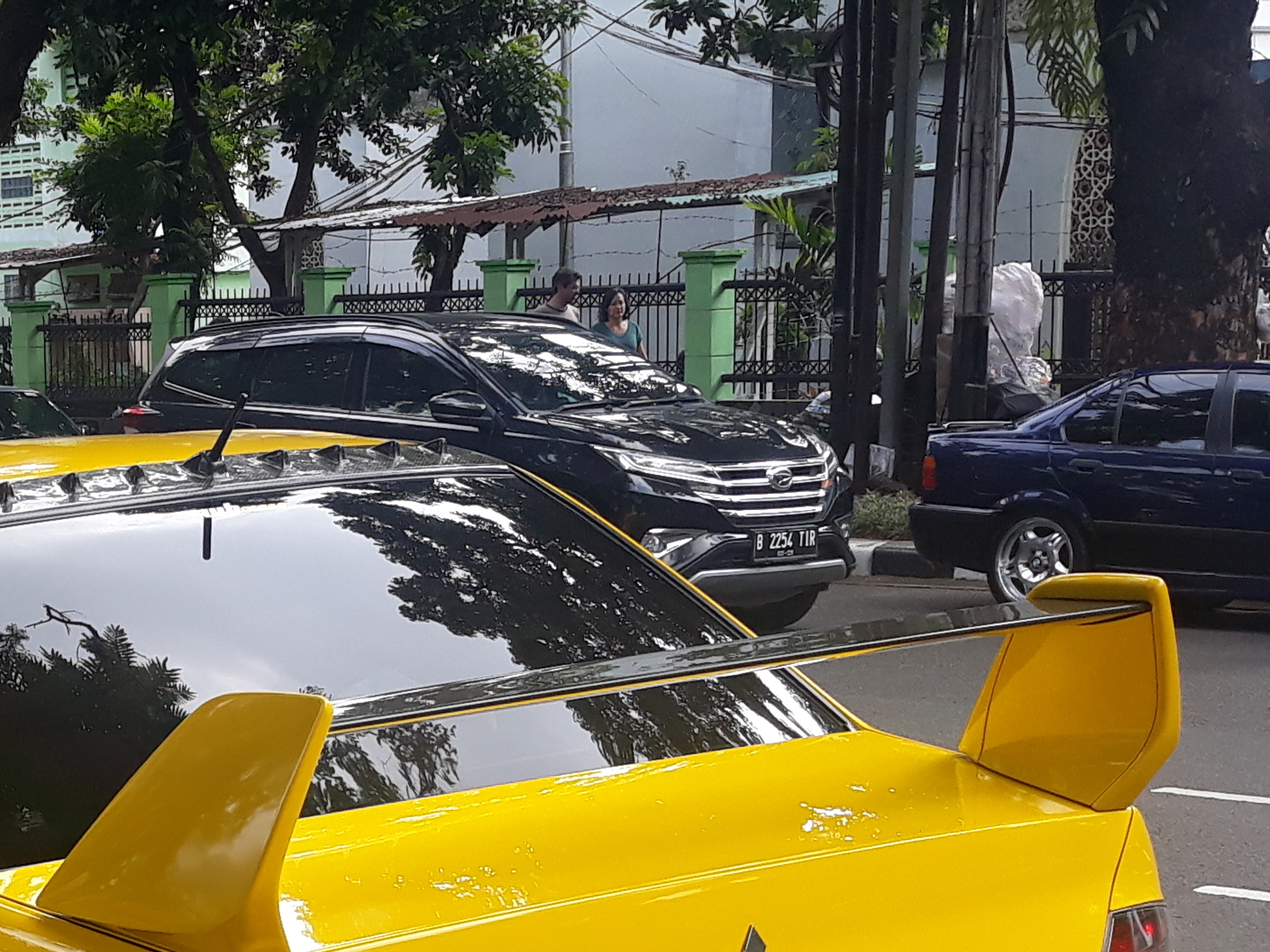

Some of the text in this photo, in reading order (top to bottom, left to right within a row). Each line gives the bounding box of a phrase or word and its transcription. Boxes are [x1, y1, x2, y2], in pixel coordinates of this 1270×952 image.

[756, 529, 816, 551] B 2254 TIR
